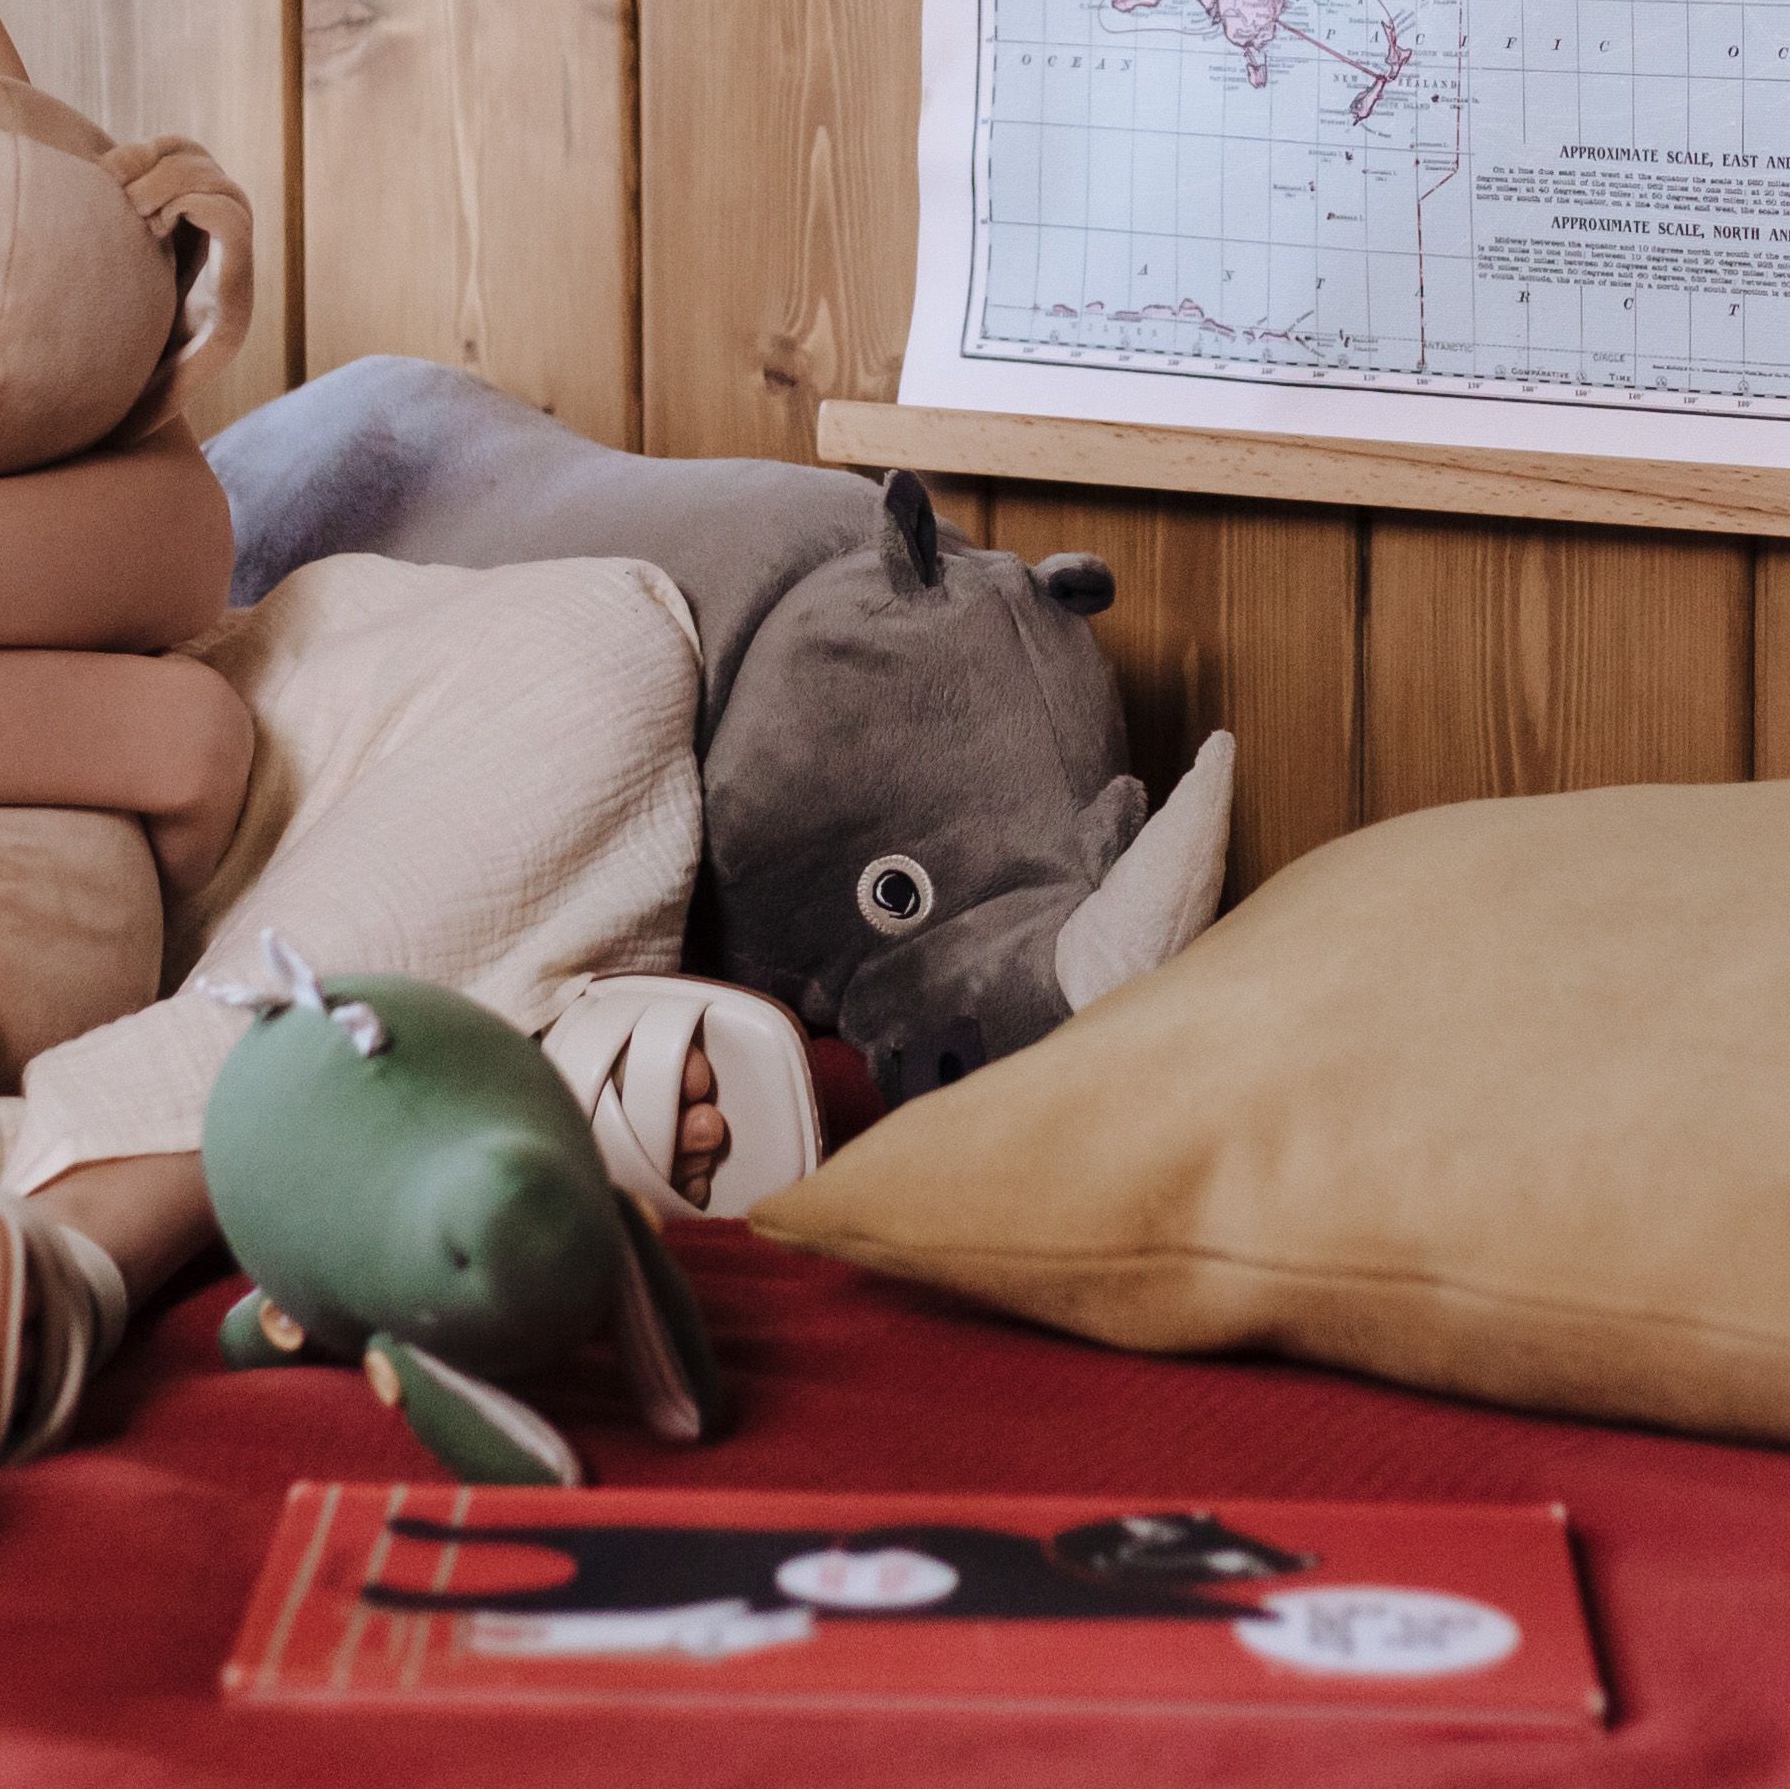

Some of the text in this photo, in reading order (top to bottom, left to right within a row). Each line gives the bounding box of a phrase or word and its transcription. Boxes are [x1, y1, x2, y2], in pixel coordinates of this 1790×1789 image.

[1325, 28, 1611, 53] PACIFIC
[1021, 53, 1134, 72] OCEAN
[1559, 145, 1659, 162] APPROXIMATE
[1667, 150, 1714, 167] SCALE,
[1722, 155, 1759, 168] EAST
[1493, 166, 1505, 174] On
[1518, 166, 1533, 175] line
[1538, 167, 1554, 176] due
[1581, 169, 1596, 178] and
[1601, 171, 1618, 179] west
[1638, 172, 1652, 180] the
[1656, 174, 1689, 184] equator
[1692, 175, 1706, 184] the
[1736, 178, 1743, 186] is
[1768, 179, 1790, 189] miles
[1551, 216, 1650, 234] APPROXIMATE
[1658, 223, 1705, 239] SCALE,
[1713, 225, 1759, 241] NORTH
[1494, 236, 1527, 246] Midway
[1531, 238, 1565, 248] between
[1568, 240, 1581, 249] the
[1585, 241, 1615, 252] equator
[1620, 242, 1635, 251] and
[1651, 243, 1684, 255] degrees
[1687, 247, 1711, 256] north
[1753, 250, 1762, 259] of
[1766, 251, 1780, 260] the
[1592, 352, 1626, 363] CIRCLE
[1511, 366, 1631, 383] COMPARATIVE TIME
